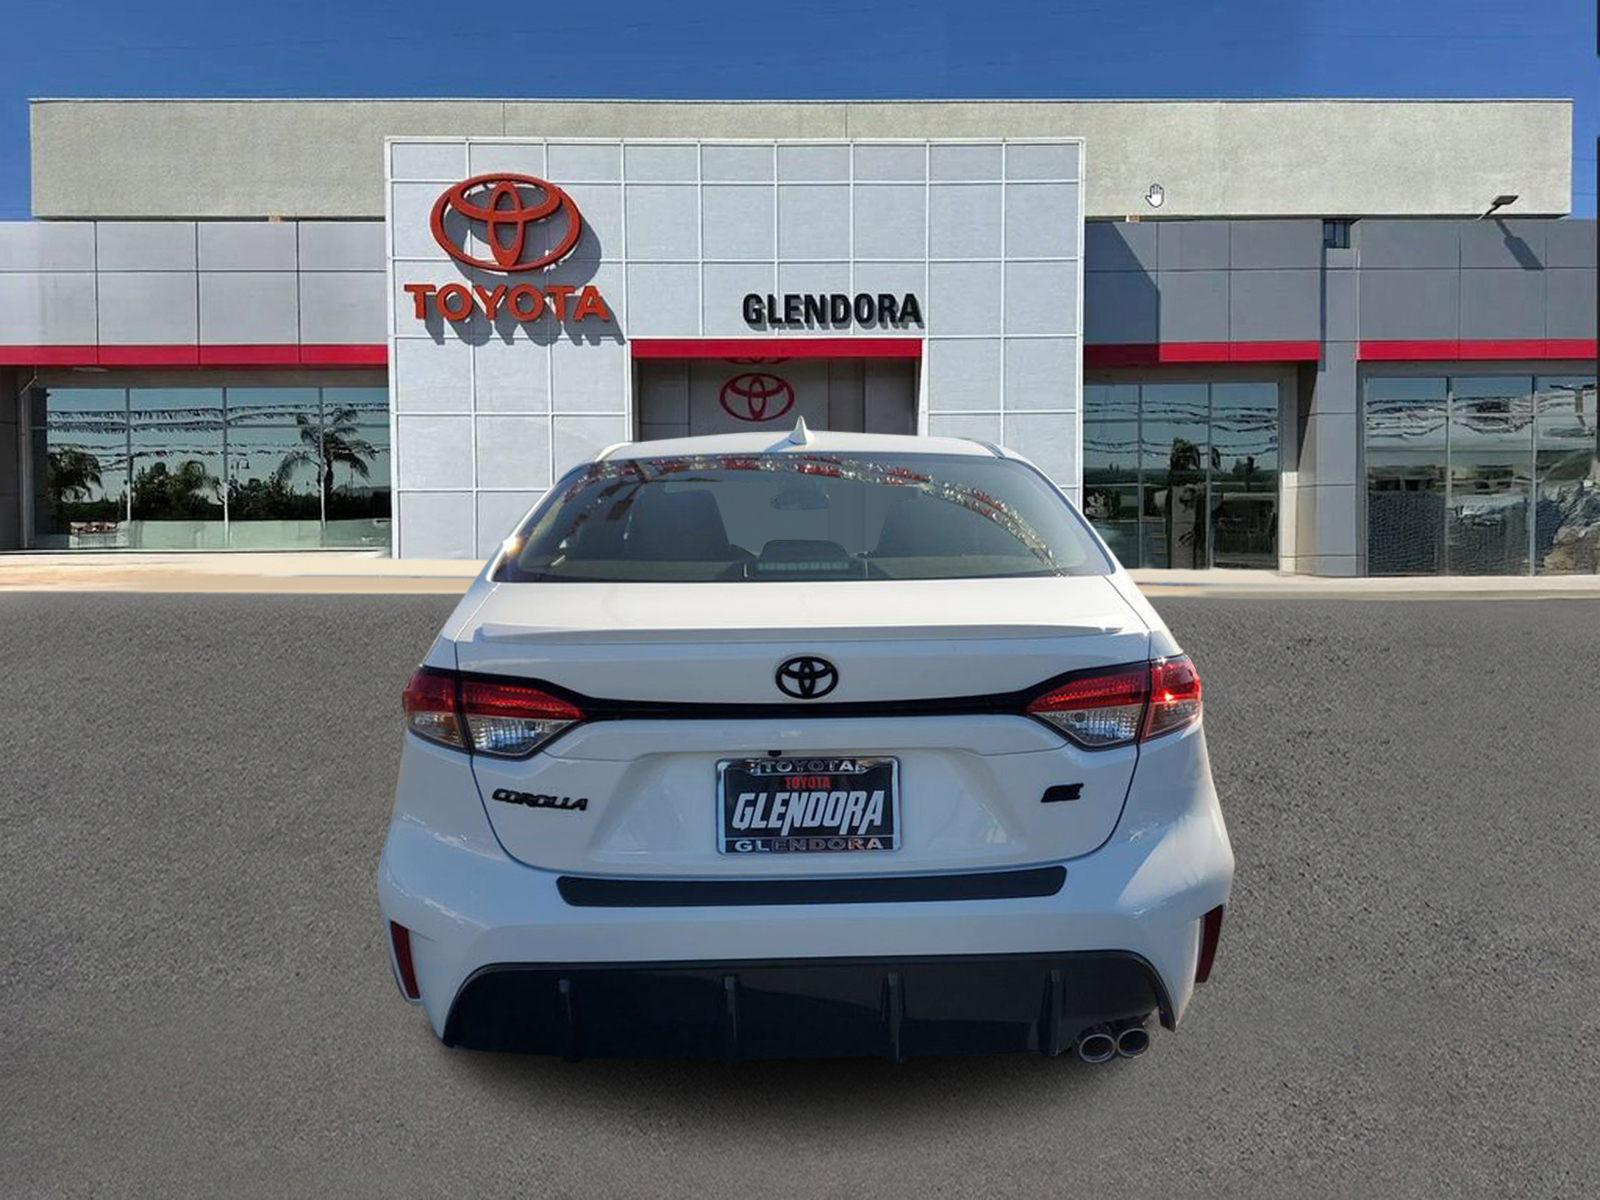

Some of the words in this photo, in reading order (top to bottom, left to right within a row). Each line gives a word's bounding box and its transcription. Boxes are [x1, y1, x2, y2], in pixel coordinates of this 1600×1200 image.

[404, 284, 610, 322] TOYOTA
[743, 293, 922, 325] GLENDORA
[762, 759, 854, 772] TOYOTA
[785, 776, 831, 789] TOYOTA
[732, 790, 885, 836] GLENDORA
[734, 838, 884, 852] GLENDORA
